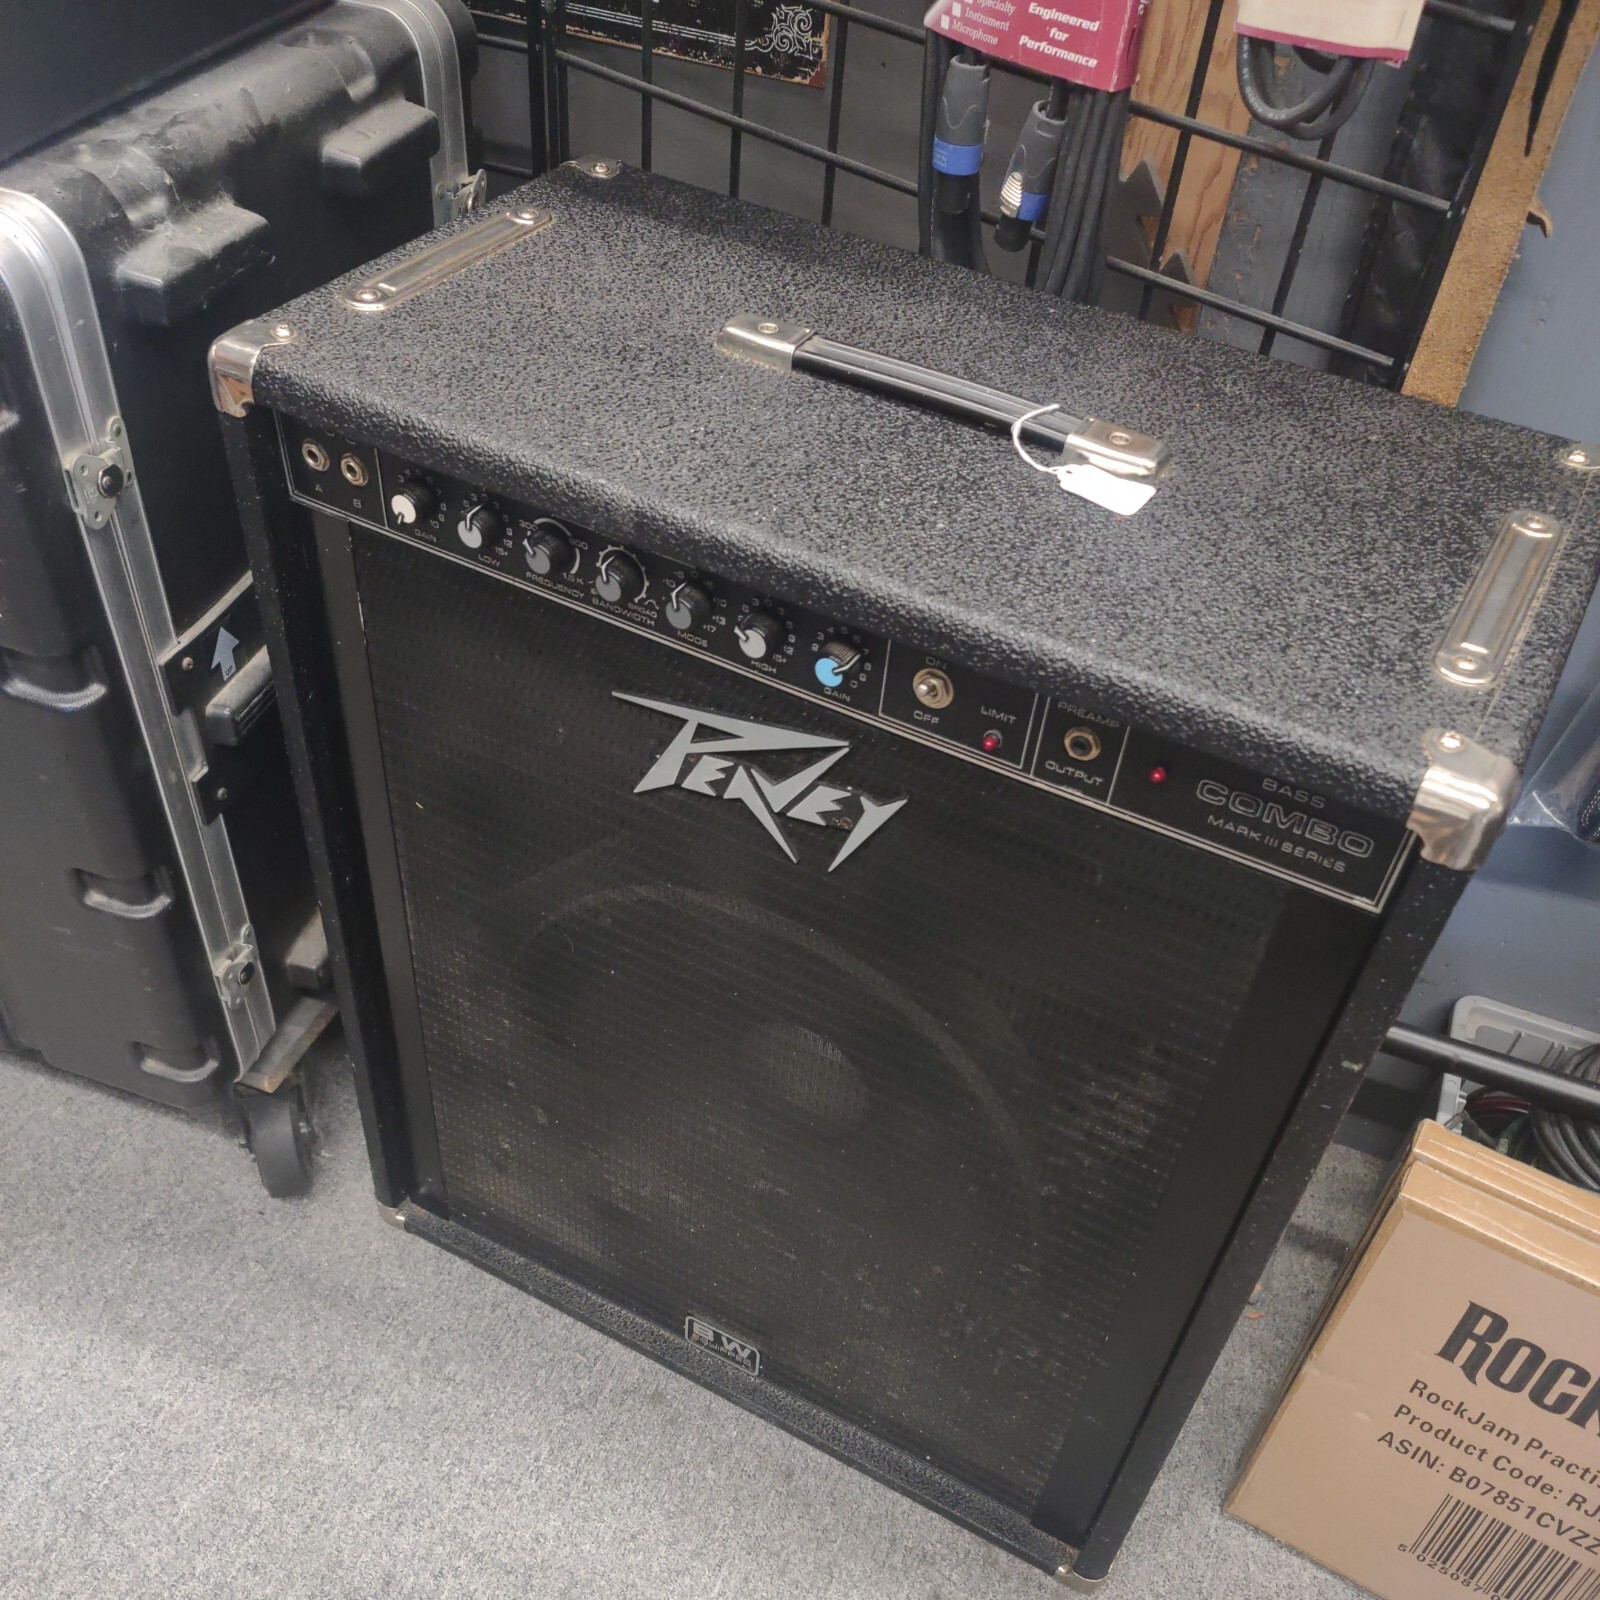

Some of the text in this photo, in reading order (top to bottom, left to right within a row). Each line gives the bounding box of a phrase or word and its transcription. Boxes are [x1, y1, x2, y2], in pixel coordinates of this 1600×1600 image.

[965, 7, 1010, 31] Instrument
[1028, 2, 1101, 32] Engineered
[952, 19, 998, 45] Microphone
[1049, 27, 1070, 41] for
[1019, 34, 1098, 68] Performance
[414, 529, 437, 542] GAIN
[478, 553, 501, 567] LOW
[526, 571, 585, 598] FREQUENCY
[592, 598, 656, 627] BANDWIDTH
[751, 660, 777, 675] HIGH
[925, 656, 947, 670] ON
[824, 687, 851, 702] GAIN
[914, 710, 940, 725] OFF
[980, 705, 1017, 725] LIMIT
[1058, 701, 1120, 729] PREAMP
[611, 691, 908, 873] PEAVEY
[1045, 760, 1104, 786] OUTPUT
[1262, 777, 1326, 809] BASS
[1196, 779, 1374, 859] COMBO
[1207, 815, 1346, 873] MARK III SERIES
[1408, 1378, 1520, 1446] RockJam
[1393, 1404, 1600, 1522] Product Code: RJ
[1377, 1431, 1600, 1556] ASIN: B07851CVZZ
